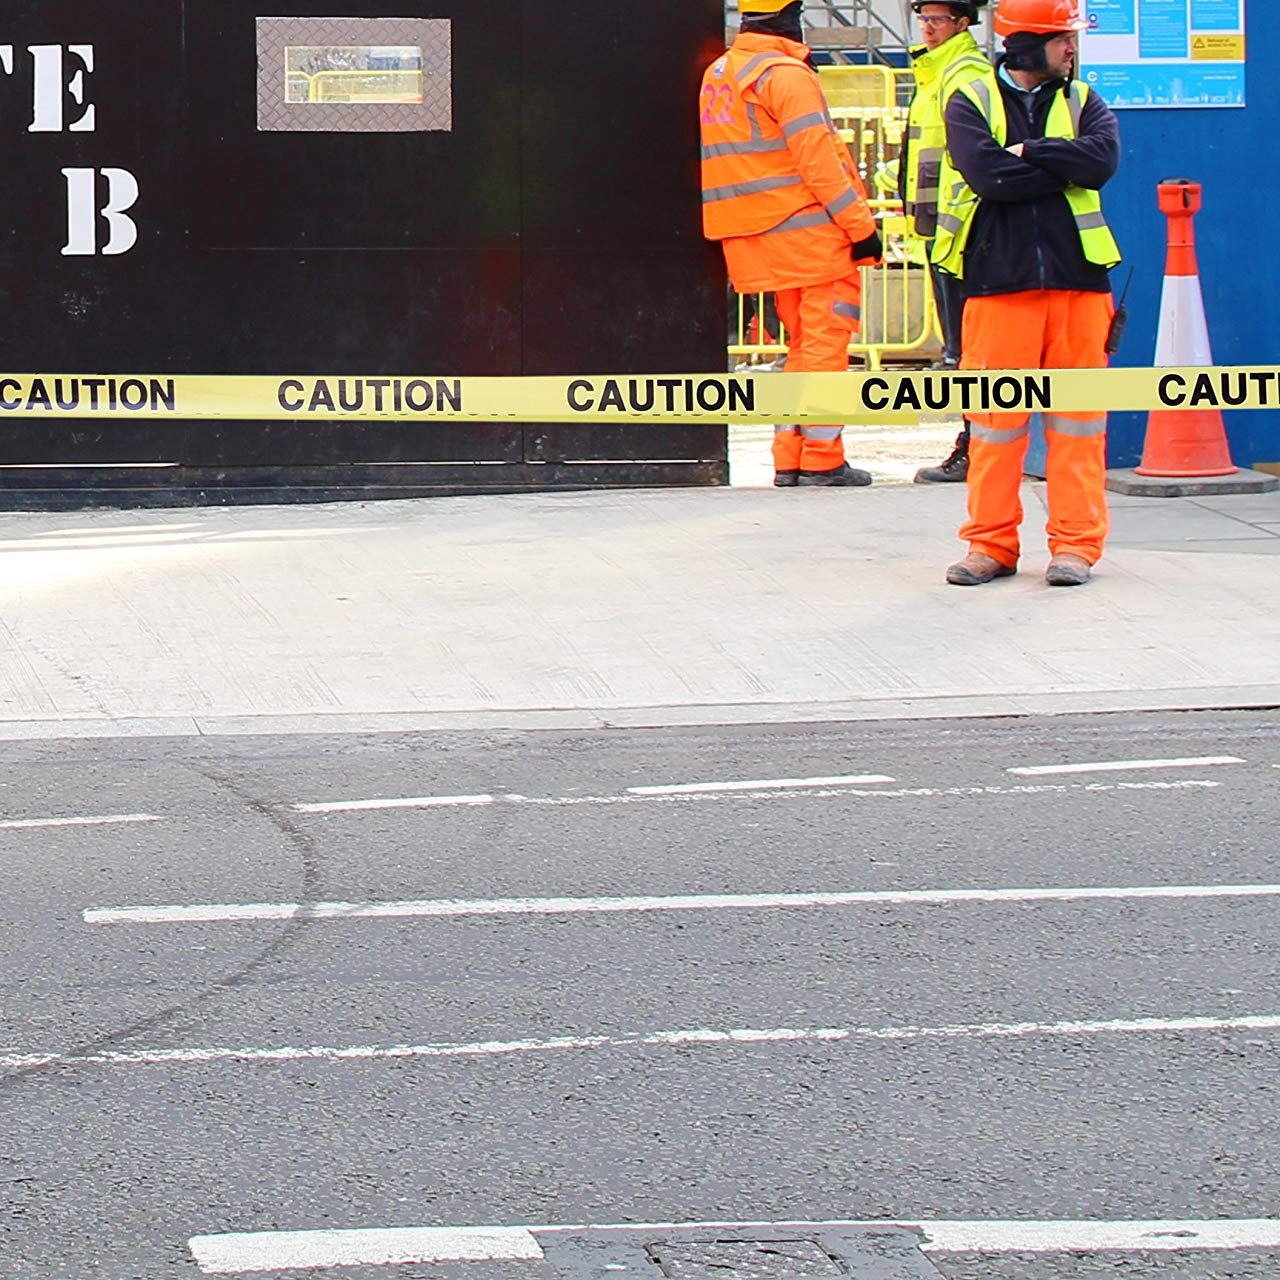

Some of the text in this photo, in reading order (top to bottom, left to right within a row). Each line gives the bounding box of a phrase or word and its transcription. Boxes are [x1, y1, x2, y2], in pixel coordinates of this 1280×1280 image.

[701, 83, 735, 125] 22
[60, 166, 140, 256] B
[277, 379, 462, 412] CAUTION
[567, 379, 755, 412] CAUTION
[860, 375, 1051, 410] CAUTION
